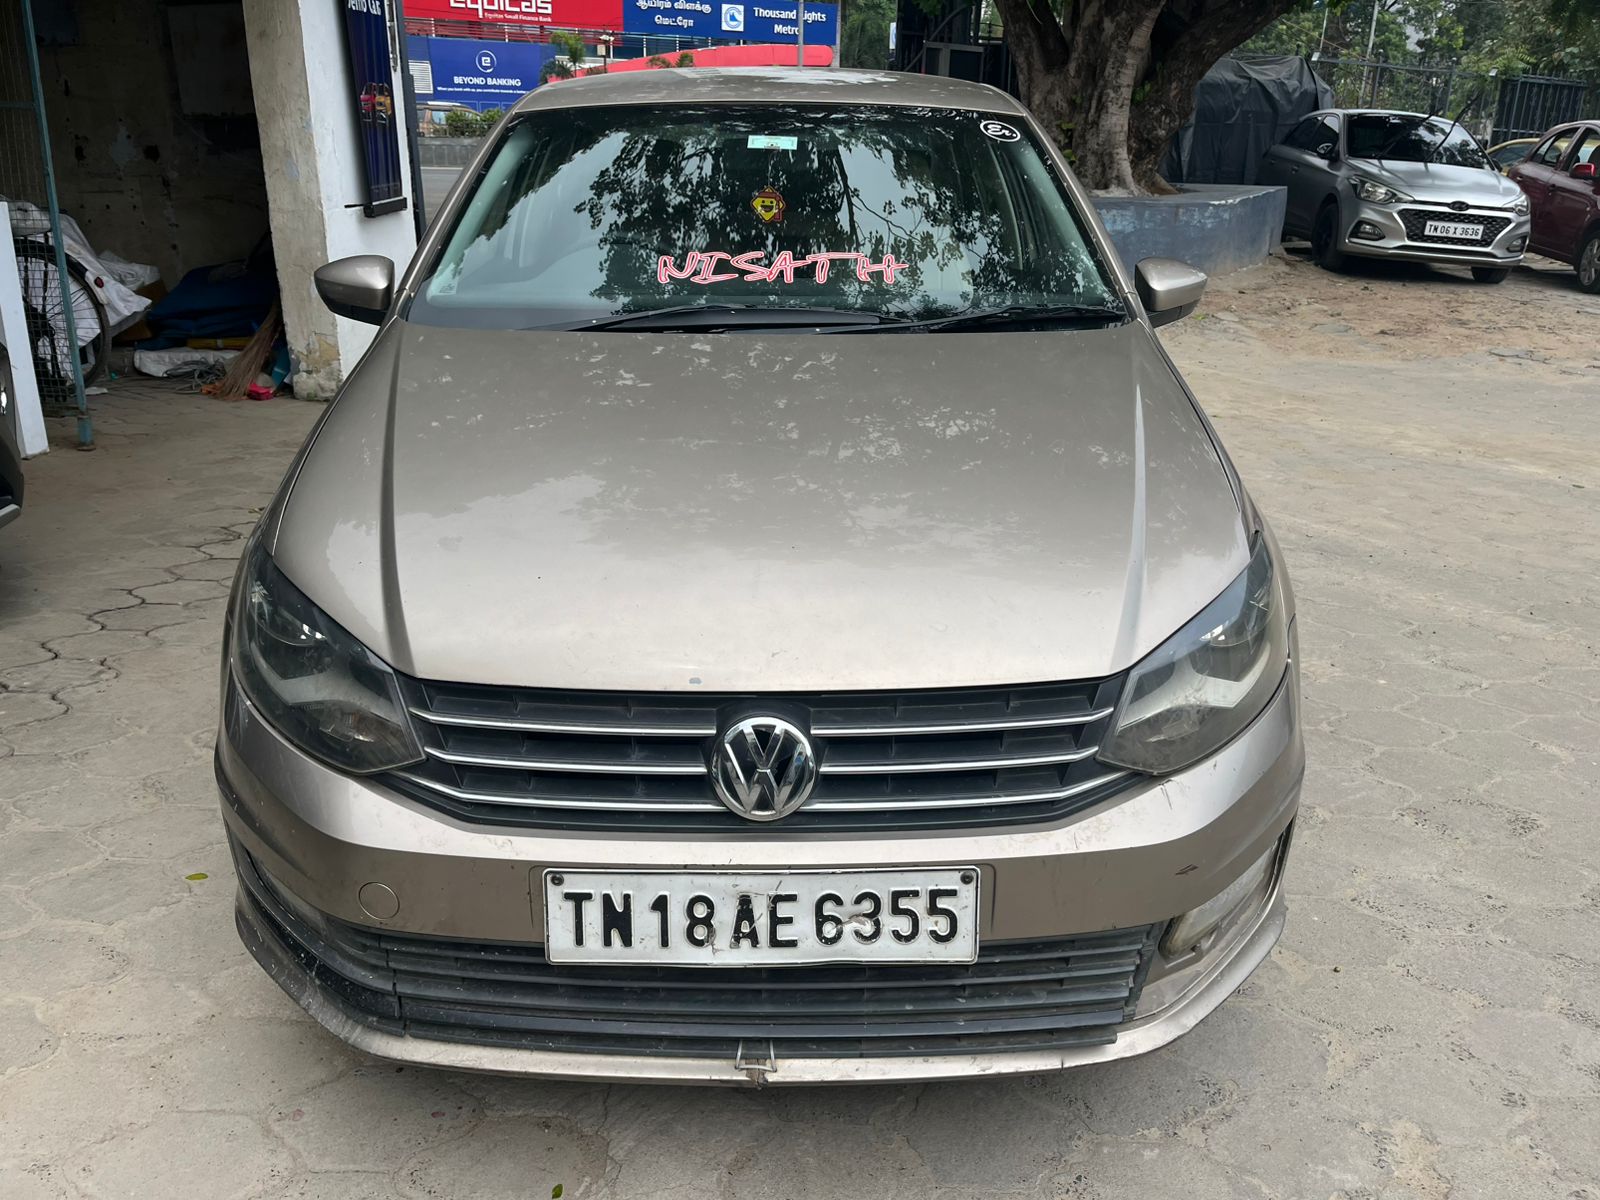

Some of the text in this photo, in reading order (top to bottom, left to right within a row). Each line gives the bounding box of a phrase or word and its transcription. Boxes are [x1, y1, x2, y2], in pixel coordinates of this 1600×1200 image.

[753, 7, 827, 23] Thousand ights
[453, 76, 522, 87] BEYOND BANKING
[1428, 223, 1481, 237] TN 06 X 3636
[657, 250, 909, 285] NISATH
